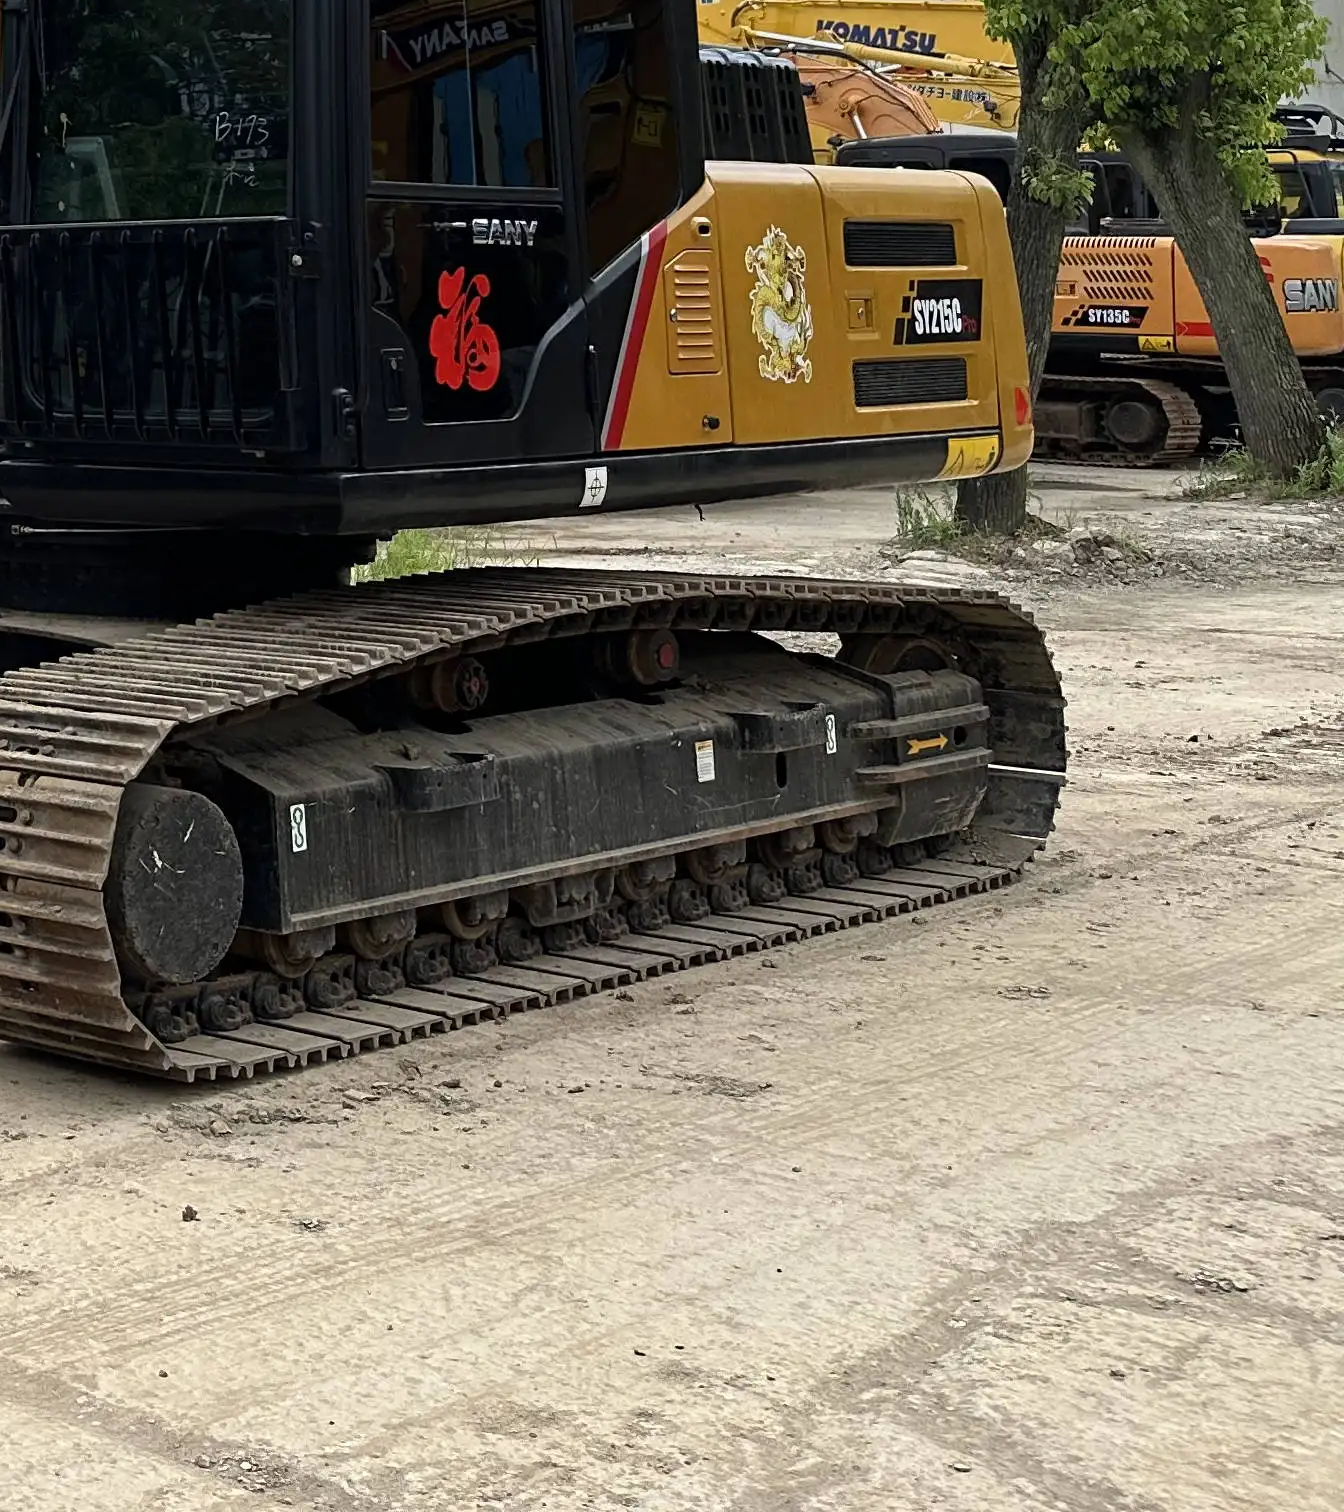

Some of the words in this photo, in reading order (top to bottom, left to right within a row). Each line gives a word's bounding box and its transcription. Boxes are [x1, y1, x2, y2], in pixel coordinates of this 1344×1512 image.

[471, 218, 538, 246] SANY
[913, 297, 962, 335] SY215C
[1088, 308, 1130, 324] SY135C
